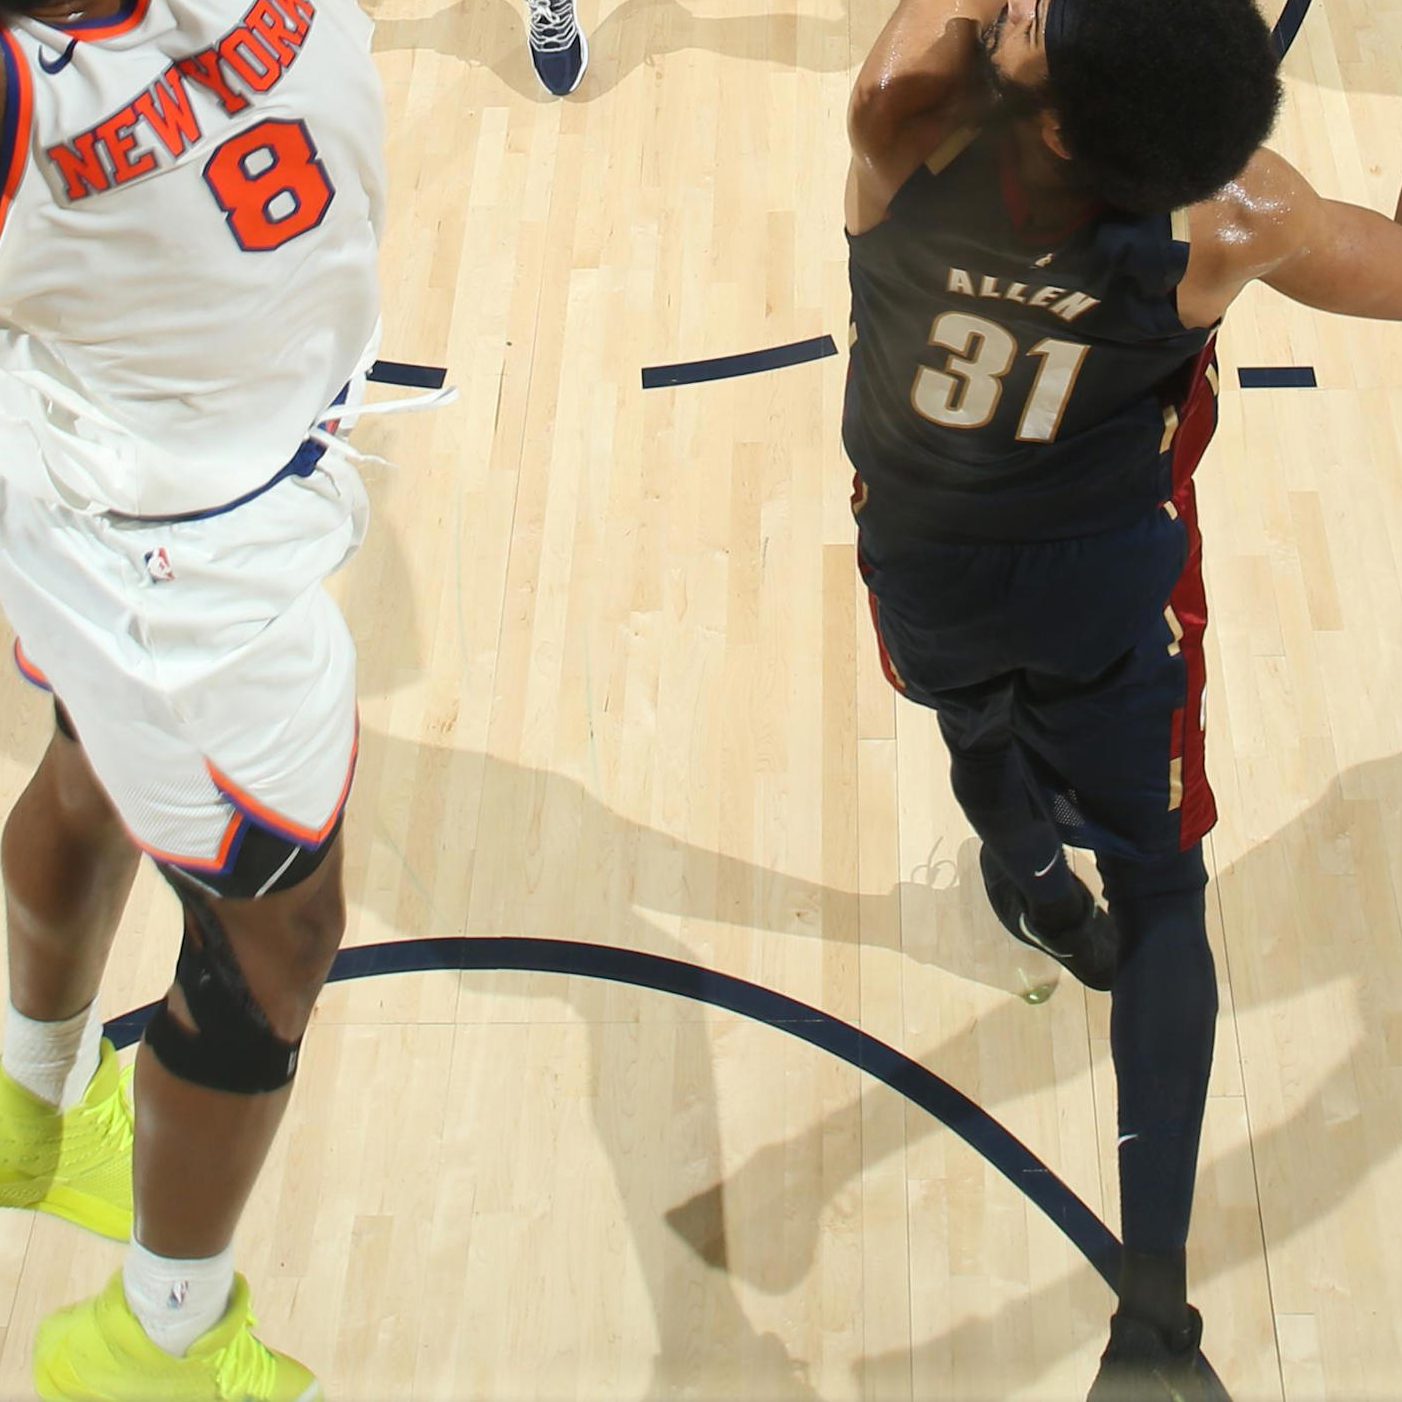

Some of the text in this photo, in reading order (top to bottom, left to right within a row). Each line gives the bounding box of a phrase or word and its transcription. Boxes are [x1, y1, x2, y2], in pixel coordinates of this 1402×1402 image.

[46, 61, 204, 203] NEW
[202, 117, 336, 252] 8
[945, 266, 1102, 323] ALLEN
[909, 310, 1092, 444] 31
